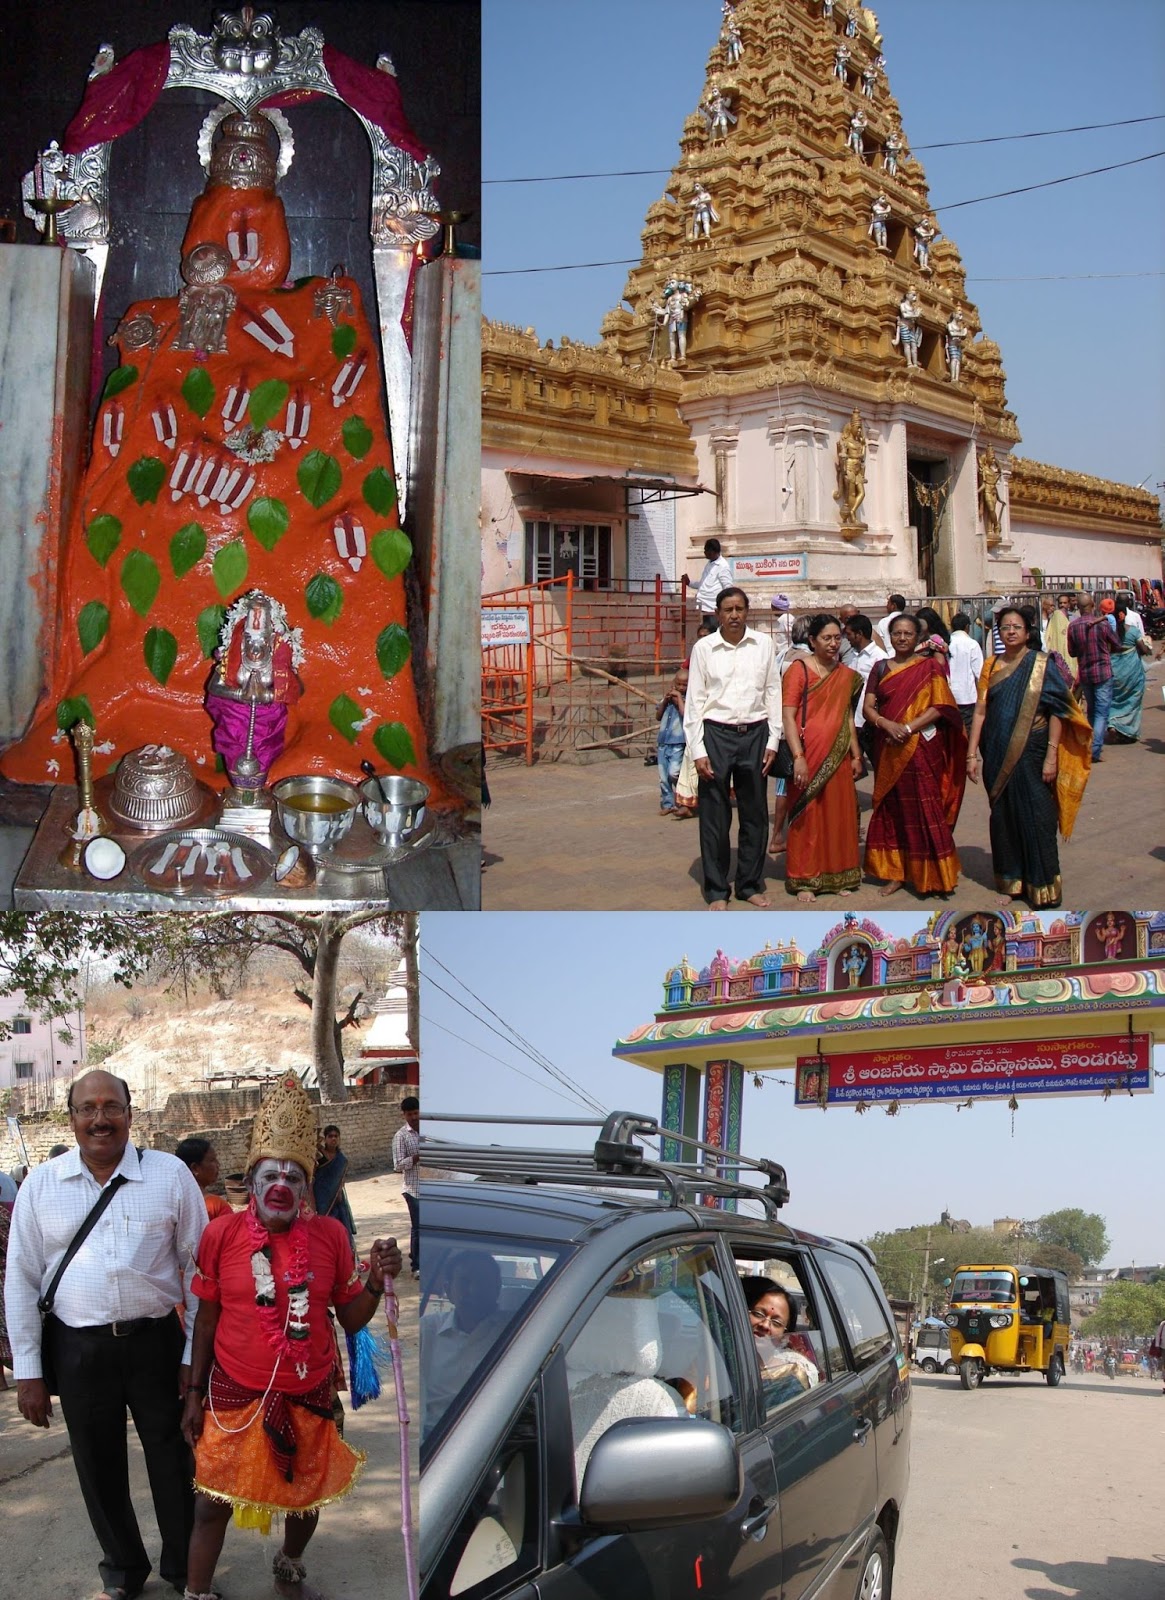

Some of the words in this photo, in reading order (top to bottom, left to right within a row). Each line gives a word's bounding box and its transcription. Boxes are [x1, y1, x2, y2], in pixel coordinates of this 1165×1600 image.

[842, 1065, 856, 1084] శ్రీ
[859, 1062, 925, 1080] ఆంజనేయ
[928, 1062, 967, 1079] స్వామి
[970, 1057, 1057, 1077] దేవస్థానము,
[1060, 1051, 1138, 1069] కొండగట్టు
